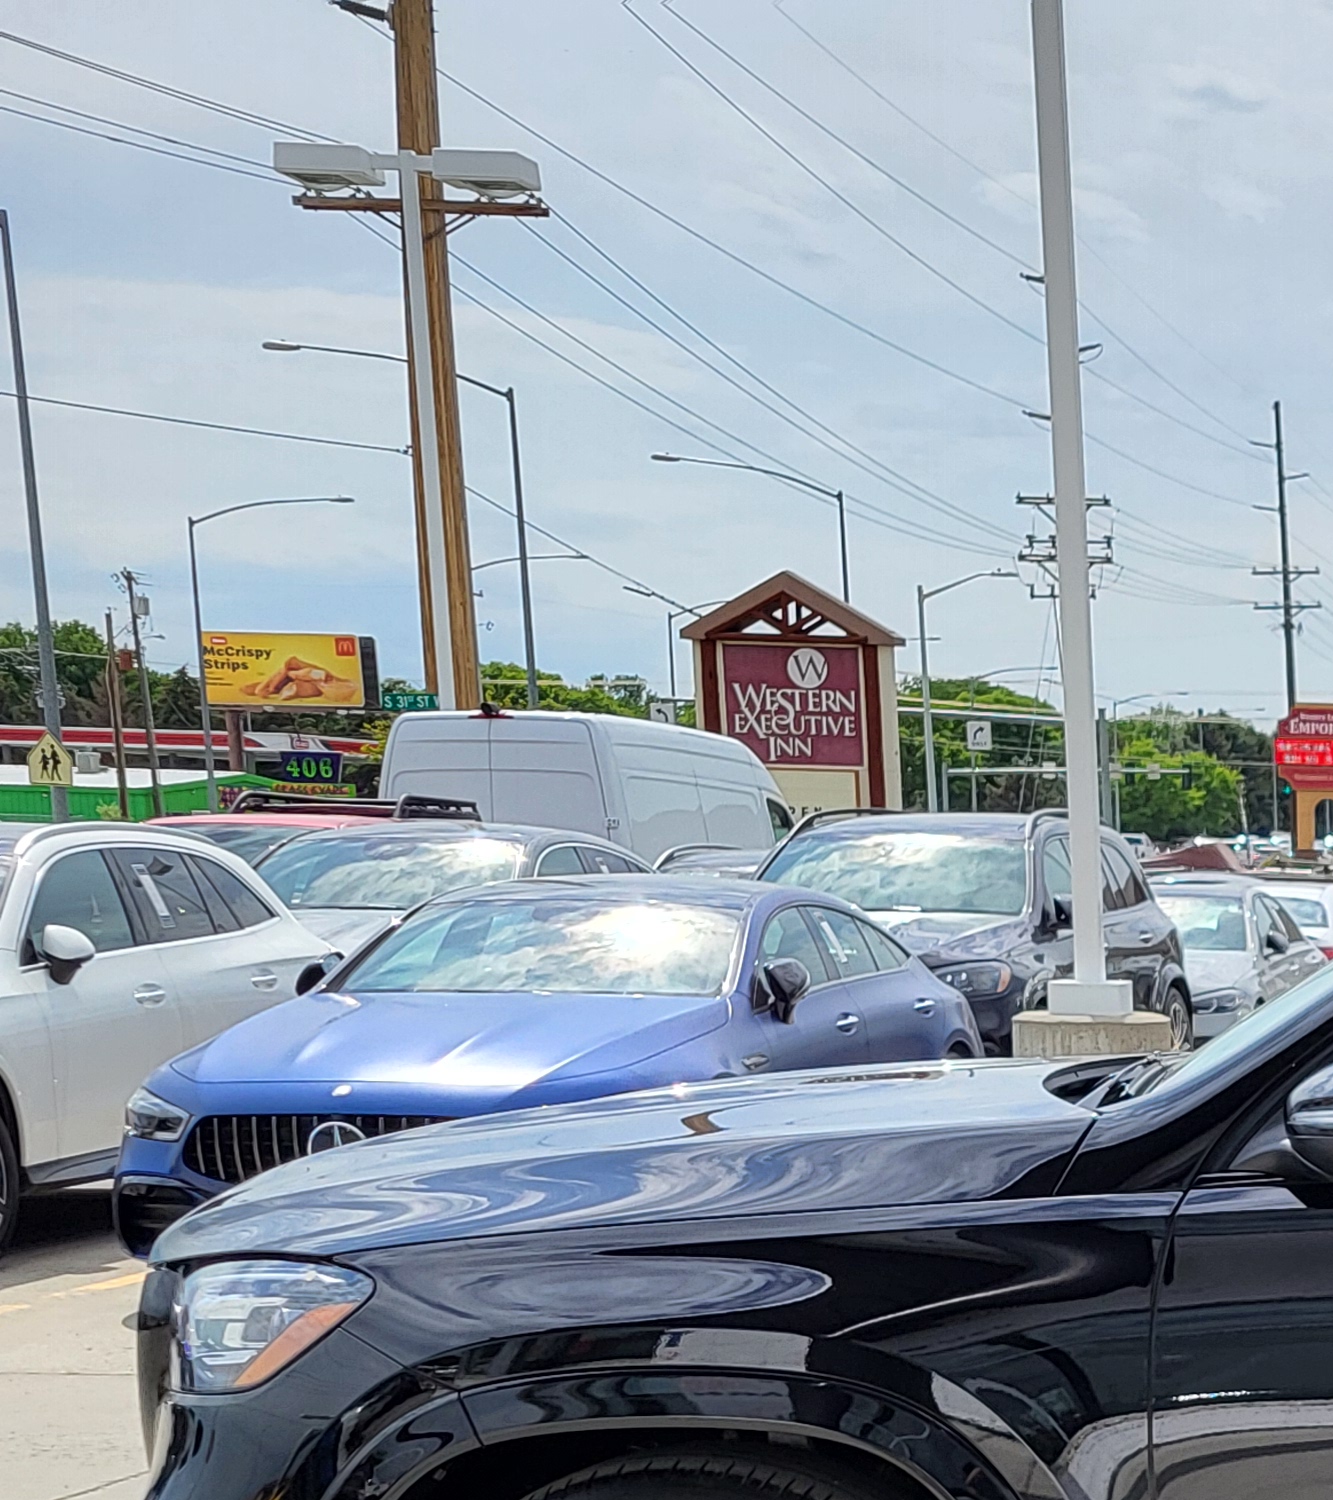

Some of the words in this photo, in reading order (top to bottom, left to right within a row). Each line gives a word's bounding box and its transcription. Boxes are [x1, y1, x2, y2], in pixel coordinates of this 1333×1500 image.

[203, 645, 272, 659] McCrispy
[203, 658, 249, 672] Strips
[793, 654, 828, 682] W
[384, 695, 393, 708] S
[416, 695, 430, 708] ST
[732, 683, 856, 724] WESTERN
[734, 707, 857, 738] EXECUTIVE
[768, 736, 812, 761] INN
